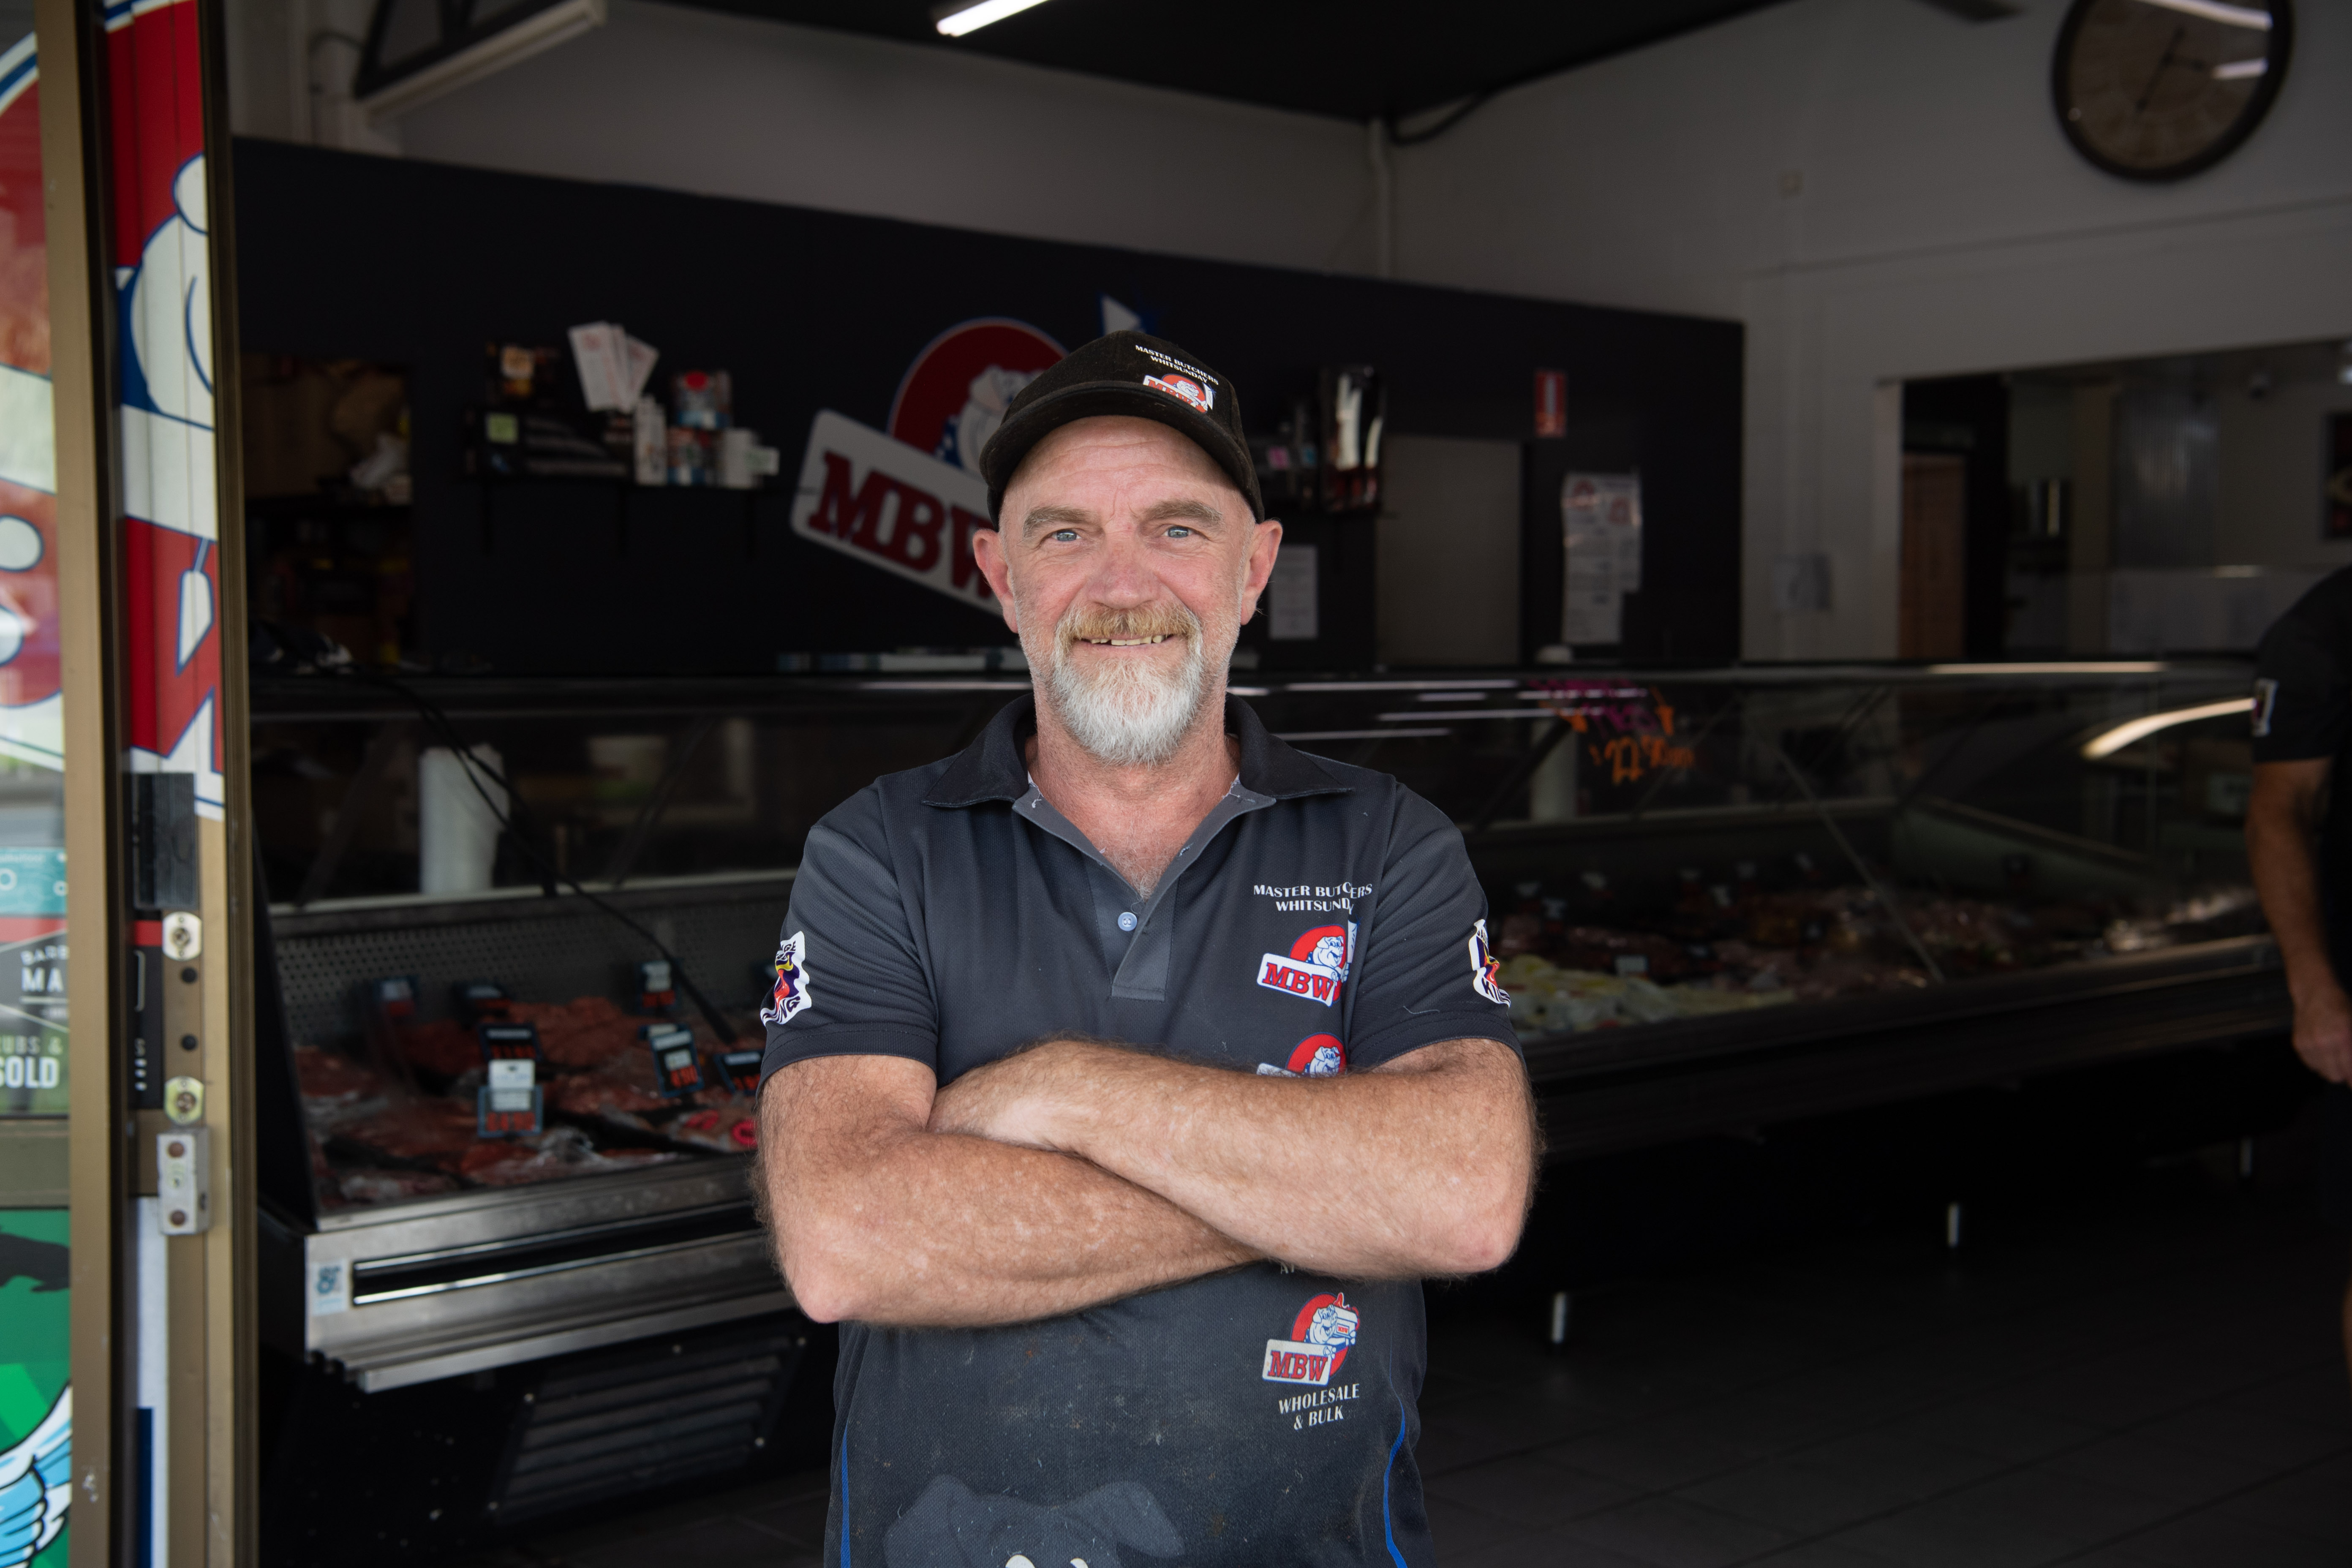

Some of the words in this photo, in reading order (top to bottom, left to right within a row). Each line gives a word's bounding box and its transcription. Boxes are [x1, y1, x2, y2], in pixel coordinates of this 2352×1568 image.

[1135, 345, 1172, 362] MASTER
[1174, 359, 1219, 385] BUTCHERS
[1150, 355, 1207, 383] WHITSUNDAY
[1254, 885, 1310, 897] MASTER
[1315, 882, 1372, 899] BUTCERS
[1276, 898, 1354, 915] WHITSUNDY
[1263, 962, 1334, 1001] MBW
[0, 1035, 41, 1055] UBS
[1268, 1350, 1328, 1381] MBW
[1279, 1383, 1360, 1414] WHOLESALE
[1293, 1415, 1303, 1431] &
[1309, 1405, 1344, 1426] BULK
